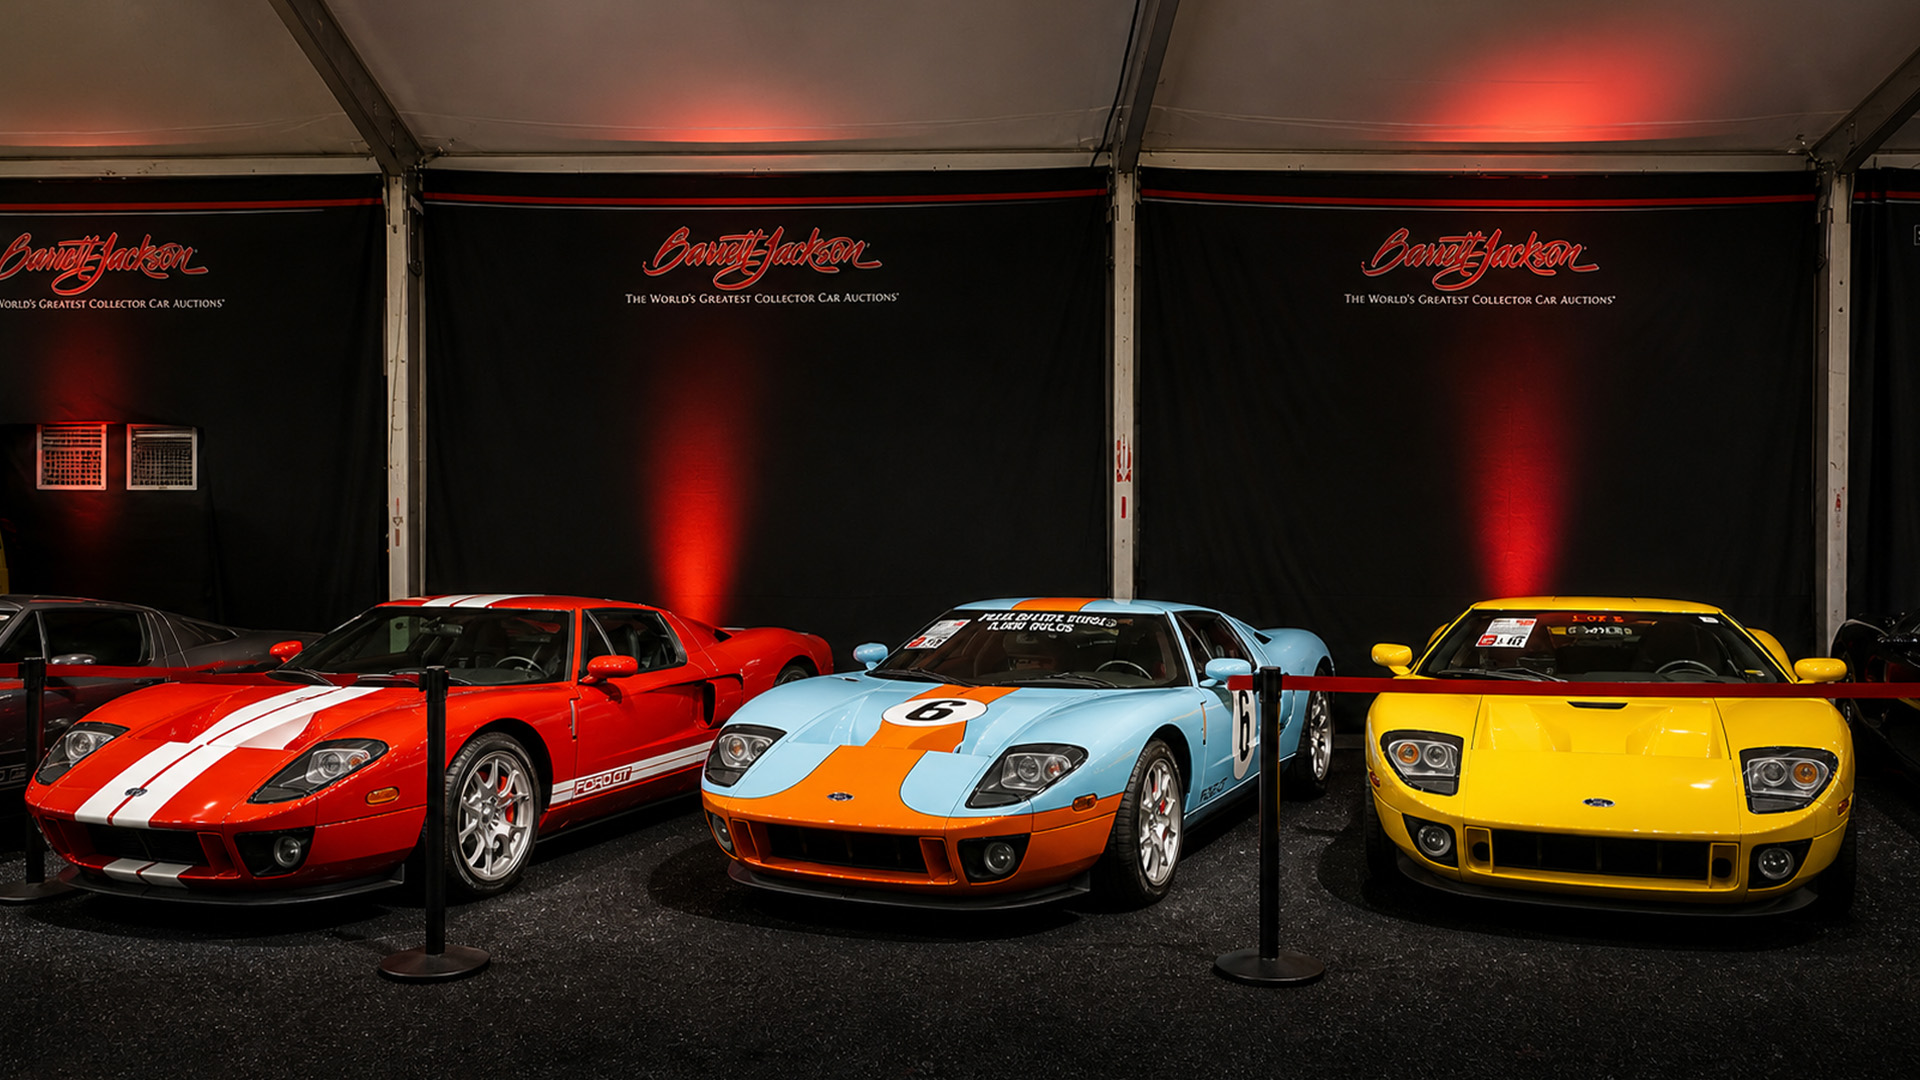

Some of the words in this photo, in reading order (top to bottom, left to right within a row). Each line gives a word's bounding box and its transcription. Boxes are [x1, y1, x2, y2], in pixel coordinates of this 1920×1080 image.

[642, 226, 883, 290] Barrett-Jackson
[1360, 227, 1600, 291] Barrett-Jackson
[38, 298, 87, 309] GREATEST
[89, 298, 147, 309] COLLECTOR
[149, 298, 170, 309] CAR
[625, 293, 647, 304] THE
[649, 293, 696, 304] WORLD'S
[699, 293, 752, 304] GREATEST
[754, 293, 816, 304] COLLECTOR
[818, 292, 841, 303] CAR
[1344, 293, 1366, 304] THE
[1368, 293, 1415, 305] WORLD'S
[1417, 294, 1469, 305] GREATEST
[1471, 294, 1532, 305] COLLECTOR
[1535, 294, 1558, 305] CAR
[905, 700, 967, 721] 6
[1238, 689, 1251, 762] 6
[576, 773, 611, 794] FORD
[613, 768, 632, 783] GT
